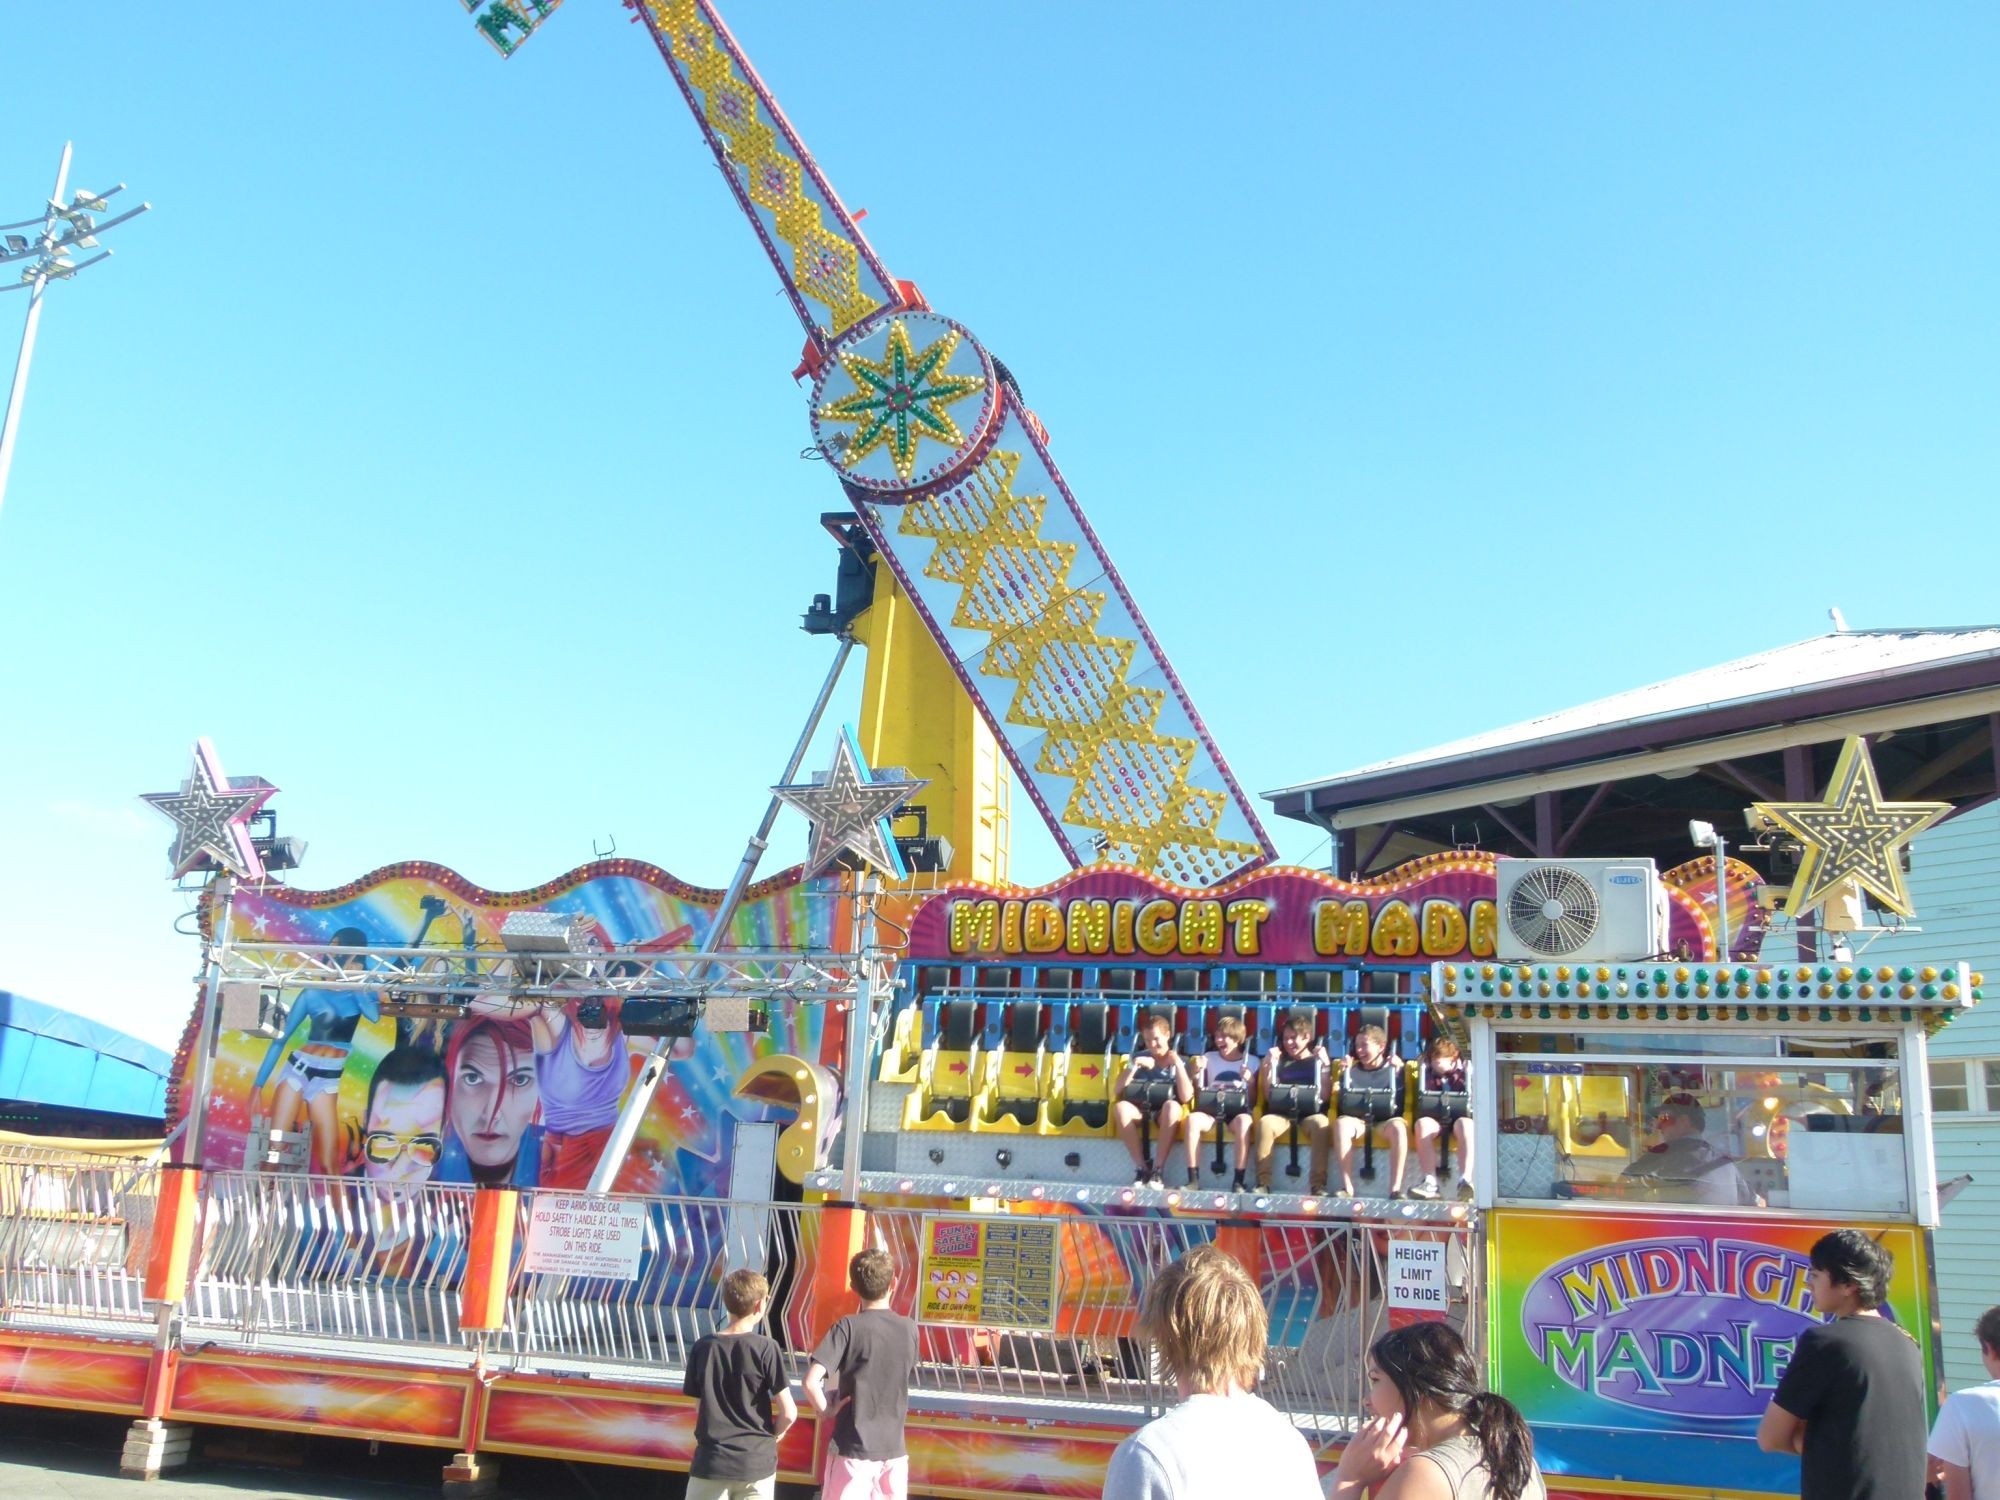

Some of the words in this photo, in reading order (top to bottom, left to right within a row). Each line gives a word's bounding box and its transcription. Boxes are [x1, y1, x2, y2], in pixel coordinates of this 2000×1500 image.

[948, 899, 1269, 957] MIDNIGHT
[1313, 899, 1499, 957] MADN
[555, 1200, 569, 1210] KEEP
[570, 1201, 588, 1211] ARMS
[588, 1201, 606, 1212] INSIDE
[535, 1212, 550, 1222] HOLD
[551, 1212, 573, 1224] SAFETY
[574, 1213, 597, 1225] HANDLE
[599, 1215, 607, 1226] AT
[608, 1216, 619, 1227] ALL
[549, 1226, 571, 1237] STROBE
[572, 1227, 592, 1239] LIGHTS
[593, 1229, 604, 1240] ARE
[606, 1230, 621, 1241] USED
[939, 1226, 962, 1236] FUN
[563, 1240, 573, 1251] ON
[575, 1241, 587, 1252] THIS
[935, 1231, 977, 1247] SAFETY
[939, 1242, 973, 1254] GUIDE
[1395, 1247, 1439, 1261] HEIGHT
[1401, 1268, 1432, 1281] LIMIT
[1555, 1241, 1826, 1324] MIDNIGH
[1394, 1286, 1409, 1298] TO
[1413, 1288, 1440, 1301] RIDE
[926, 1302, 941, 1310] RIDE
[950, 1303, 964, 1311] OWN
[963, 1304, 977, 1312] RISK
[1535, 1319, 1798, 1396] MADNE
